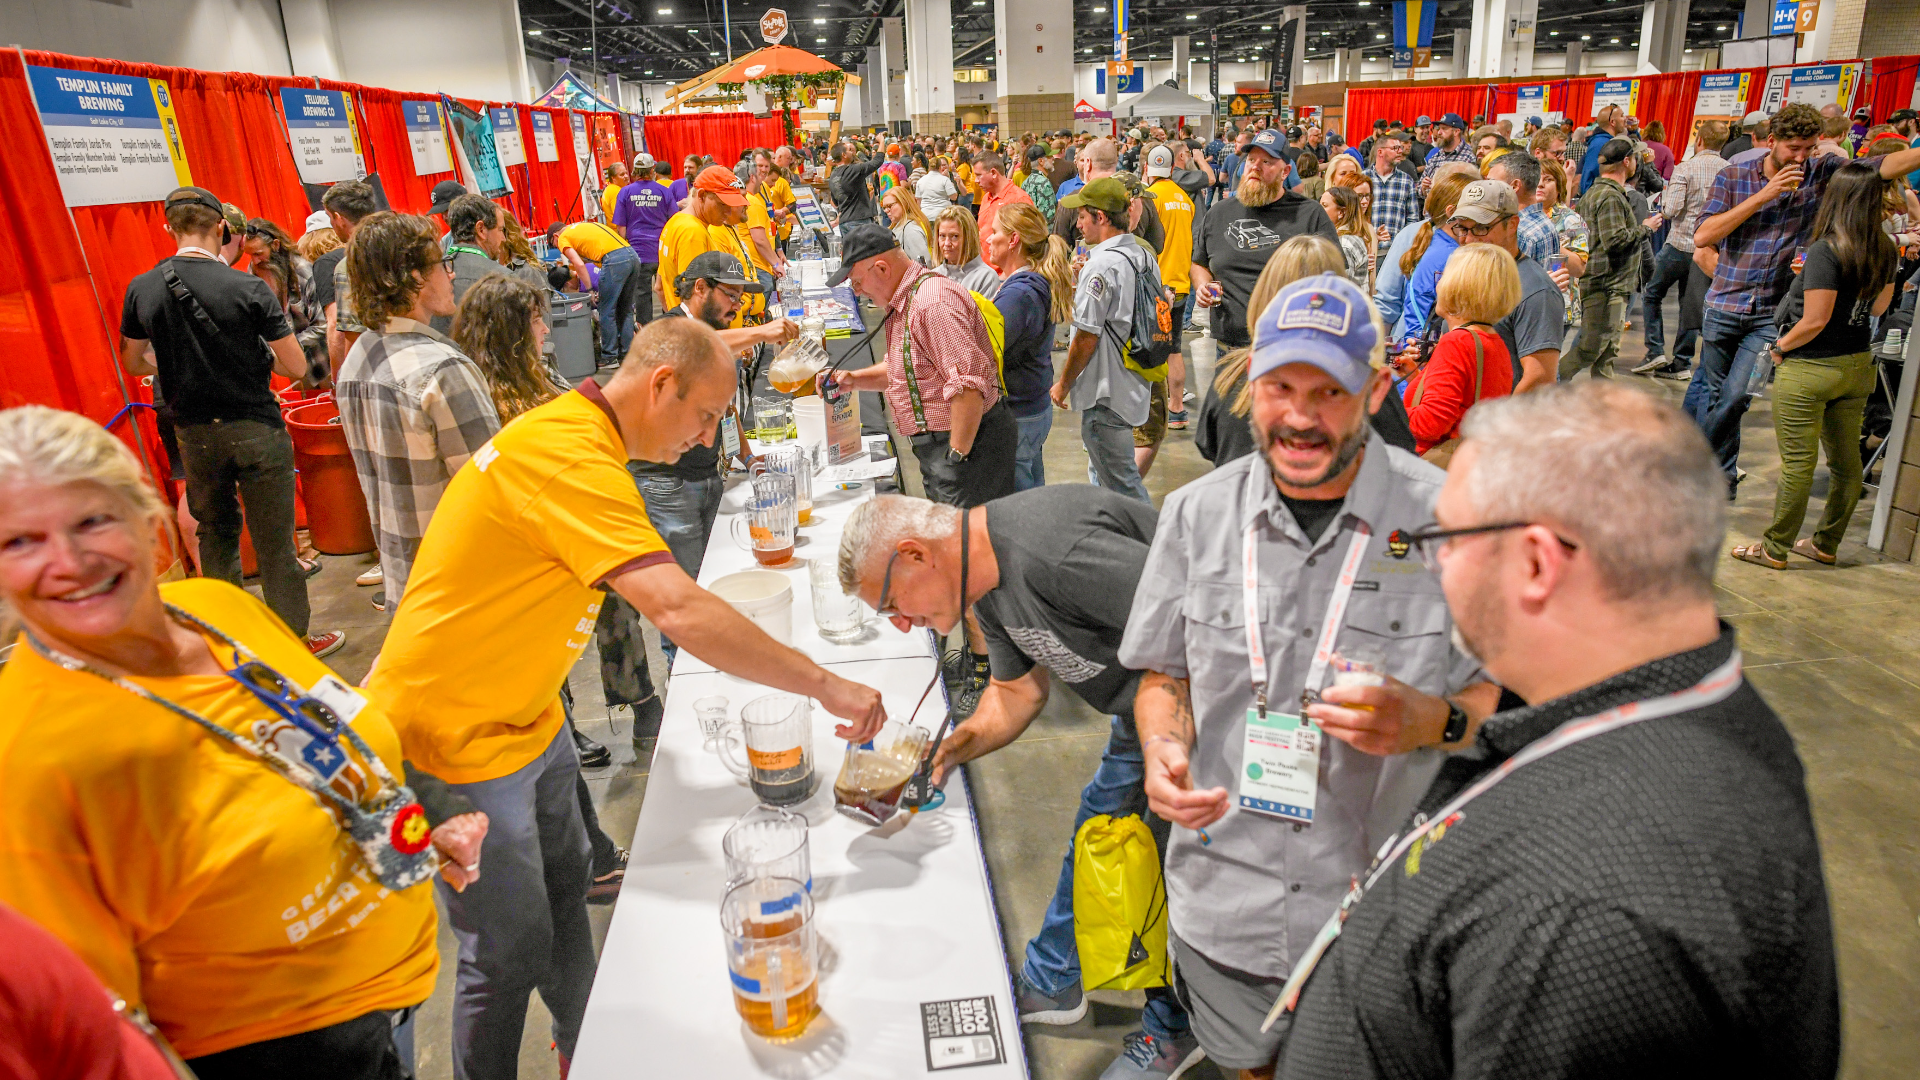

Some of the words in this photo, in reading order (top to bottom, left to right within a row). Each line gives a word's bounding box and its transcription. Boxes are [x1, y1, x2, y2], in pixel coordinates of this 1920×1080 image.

[1774, 8, 1797, 23] H-K
[1802, 10, 1813, 26] 9
[1395, 52, 1411, 60] E-G
[1418, 54, 1426, 64] 7
[1116, 65, 1127, 74] 10
[56, 77, 100, 94] TEMPLIN
[101, 81, 133, 96] FAMILY
[78, 95, 125, 111] BREWING
[305, 95, 329, 105] TELLURIDE
[303, 107, 327, 117] BREWING
[328, 107, 335, 117] CO
[51, 137, 71, 150] Templin
[72, 138, 88, 150] Family
[120, 139, 137, 151] Templin
[137, 139, 151, 151] Family
[53, 153, 70, 163] Templin
[71, 153, 85, 163] Family
[120, 153, 137, 165] Templin
[137, 153, 150, 165] Family
[58, 165, 74, 175] Templin
[74, 165, 87, 175] Family
[1165, 202, 1180, 211] BREW
[1265, 768, 1293, 778] Brewery
[1269, 802, 1275, 810] 2
[285, 882, 361, 945] BEER
[926, 1003, 937, 1014] IS
[937, 1001, 955, 1036] MORE
[959, 1000, 976, 1034] OVER
[973, 998, 990, 1032] POUR
[927, 1014, 940, 1038] LESS
